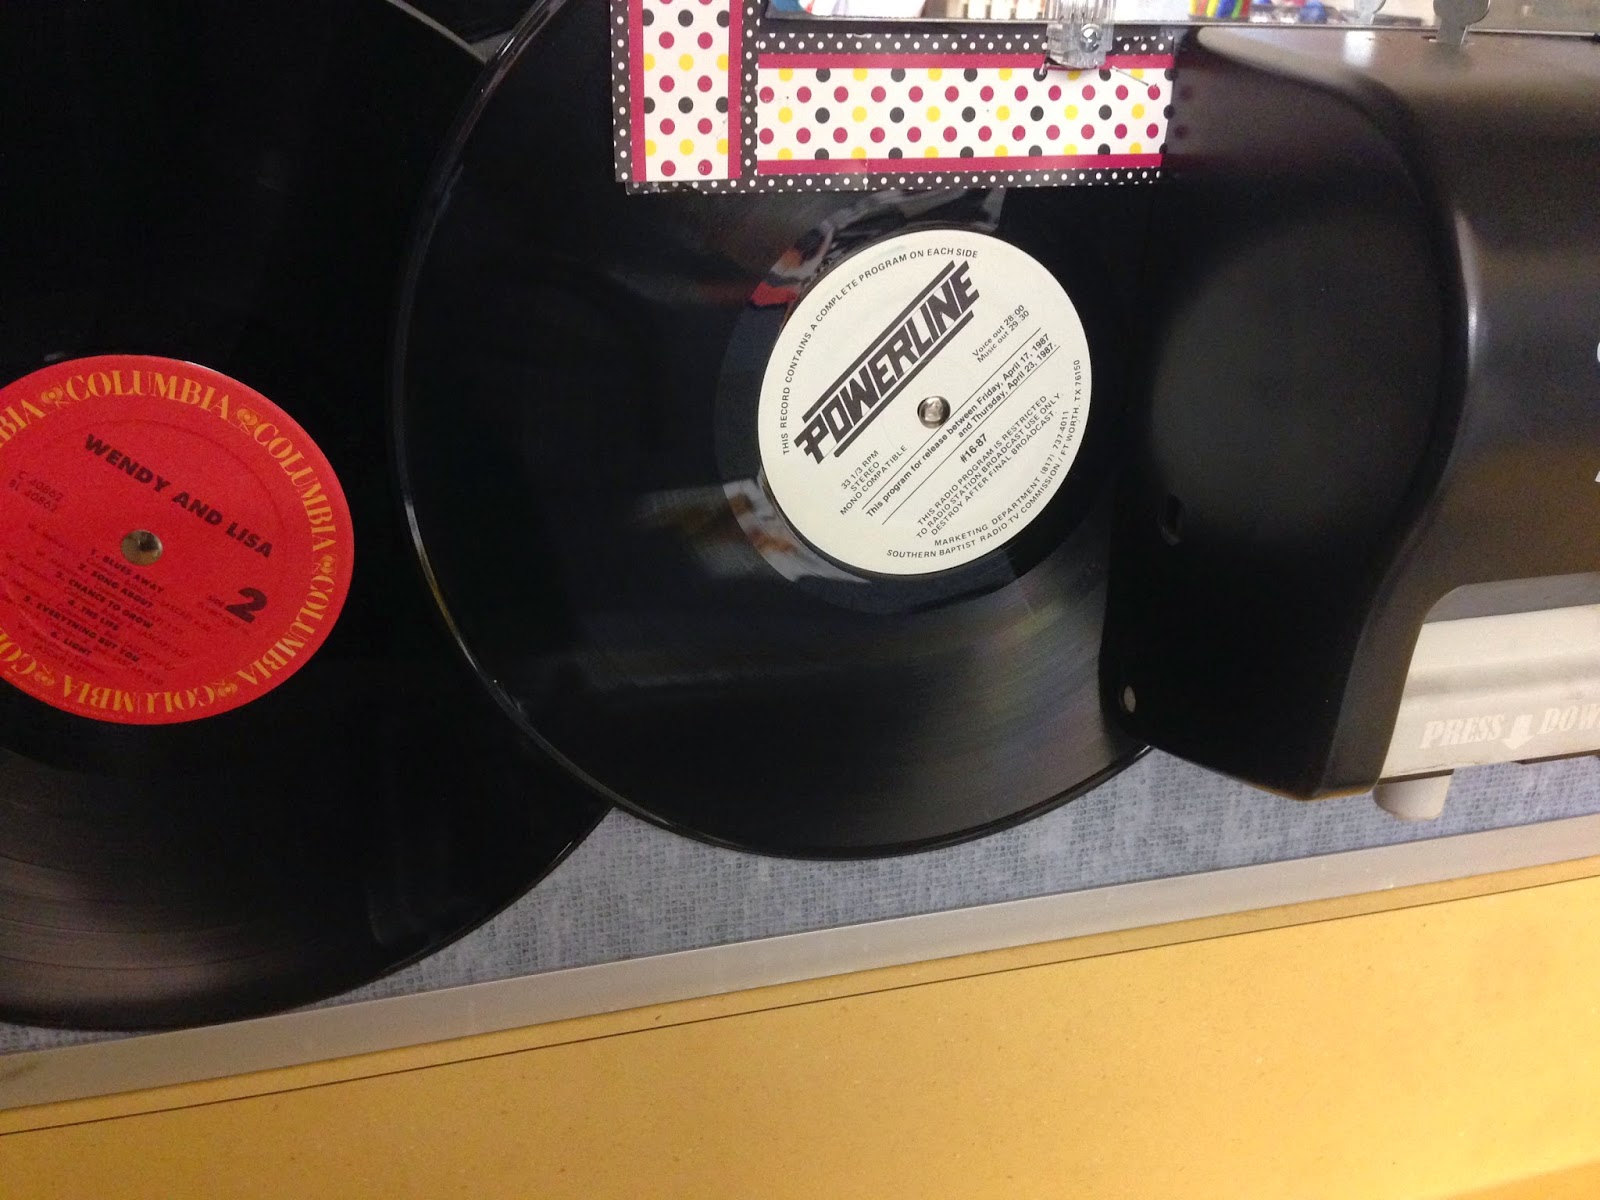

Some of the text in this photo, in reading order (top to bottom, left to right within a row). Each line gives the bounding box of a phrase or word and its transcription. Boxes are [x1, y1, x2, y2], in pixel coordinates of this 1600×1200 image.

[780, 247, 978, 455] THIS RECORD CONTAINS A COMPLETE PROGRAM ON EACH SIDE
[972, 338, 992, 356] Voice
[992, 324, 1005, 338] out
[976, 344, 997, 363] Music
[997, 330, 1010, 344] out
[794, 260, 979, 464] POWERLINE
[1074, 360, 1082, 386] 76150
[66, 370, 231, 421] COLUMBIA
[958, 342, 1057, 438] and Thursday, April 23, 1987.
[1074, 388, 1082, 402] TX
[866, 333, 1050, 517] This program for release between Friday, April 17, 1987
[918, 395, 1047, 526] THIS RADIO PROGRAM IS RESTRICTED
[960, 433, 987, 463] #16-87
[254, 422, 337, 551] COLUMBIA
[840, 444, 907, 516] MONO COMPATIBLE
[841, 450, 879, 490] 33 1/3 RPM
[850, 461, 880, 492] STEREO
[916, 528, 928, 538] TO
[927, 504, 951, 528] RADIO
[950, 473, 982, 504] STATION
[982, 429, 1025, 474] BROADCAST
[1025, 414, 1040, 430] USE
[934, 524, 989, 546] MARKETING
[991, 476, 1041, 525] DEPARTMENT
[1052, 410, 1069, 450] 737-4011
[1020, 464, 1062, 514] COMMISSION
[85, 434, 273, 558] WENDY AND LISA
[931, 501, 964, 536] DESTROY
[965, 474, 989, 502] AFTER
[988, 453, 1012, 477] FINAL
[980, 522, 1008, 542] RADIO
[1008, 512, 1020, 524] TV
[887, 549, 936, 558] SOUTHERN
[939, 540, 976, 556] BAPTIST
[91, 570, 119, 589] SONG
[120, 588, 153, 608] ABOUT
[103, 556, 132, 576] BLUES
[133, 574, 164, 594] AWAY
[68, 578, 106, 602] CHANCE
[107, 600, 120, 612] TO
[122, 609, 154, 629] GROW
[224, 587, 268, 624] 2
[36, 602, 98, 640] EVERYTHING
[98, 636, 118, 650] BUT
[120, 649, 140, 663] YOU
[100, 617, 119, 632] LIFE
[236, 575, 335, 685] COLUMBIA
[64, 636, 92, 657] LIGHT
[63, 674, 215, 714] COLUMBIA
[1420, 714, 1505, 749] PRESS
